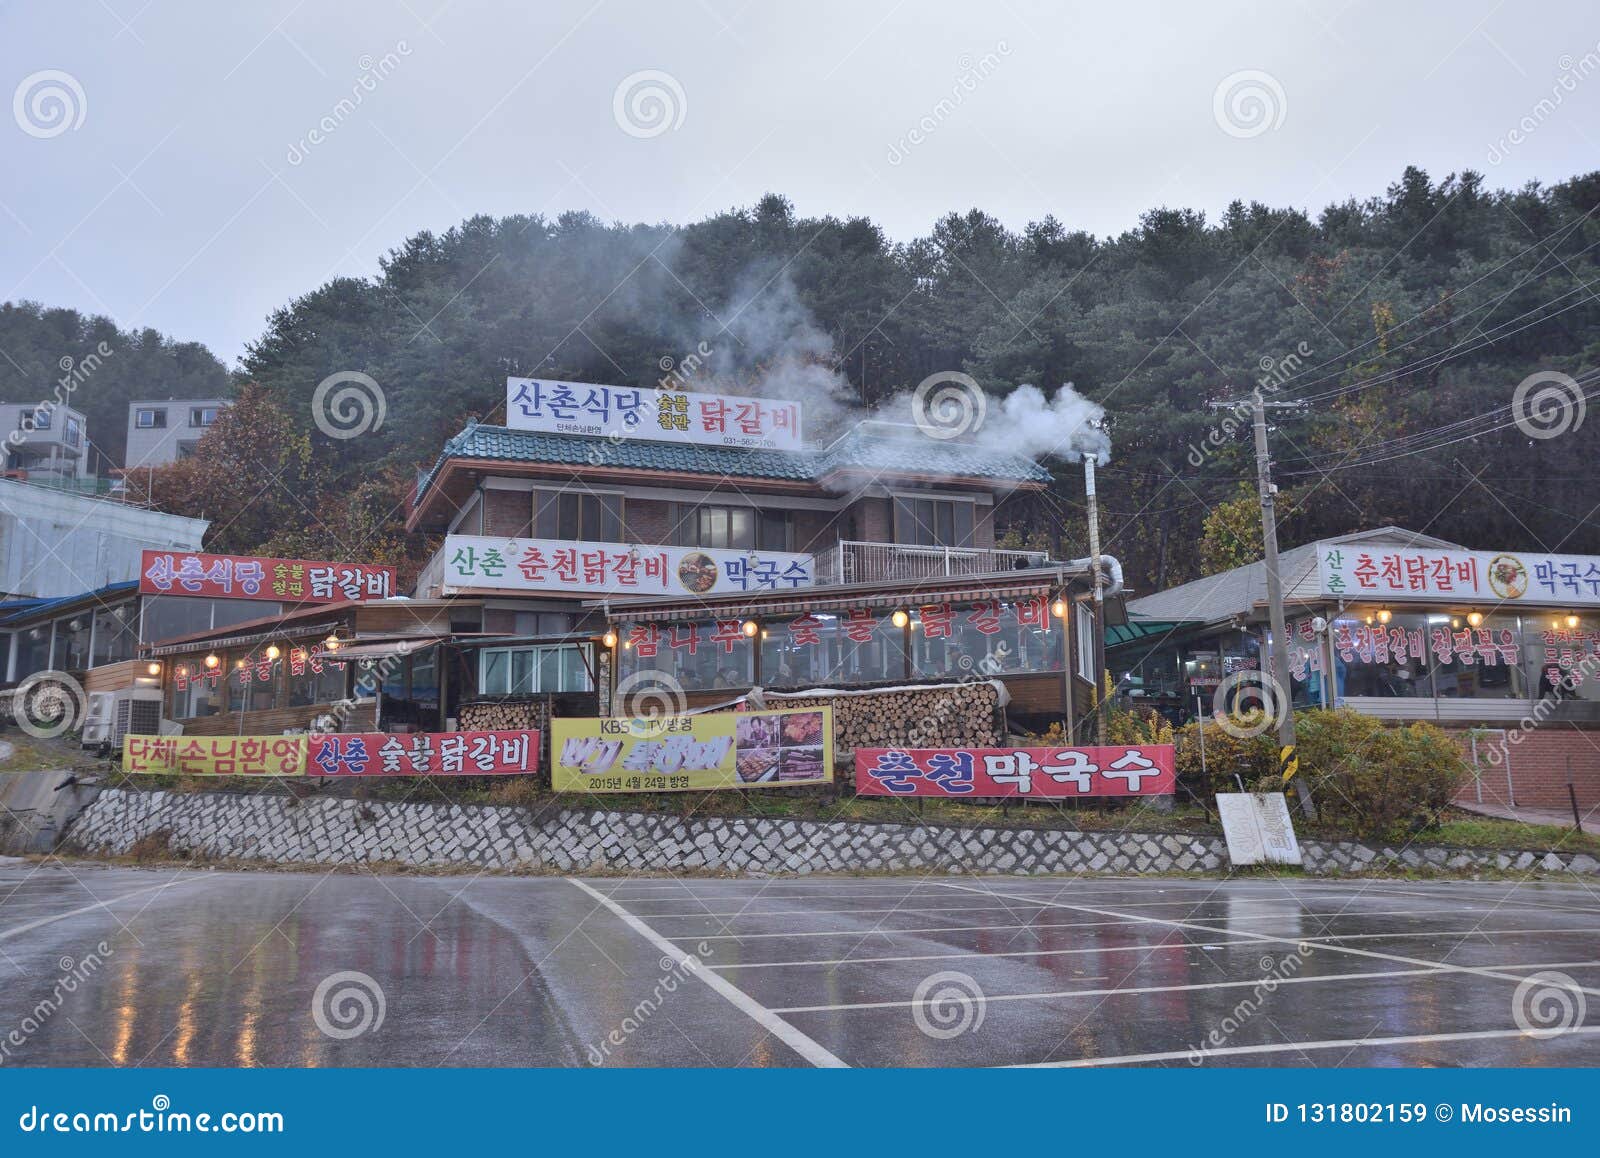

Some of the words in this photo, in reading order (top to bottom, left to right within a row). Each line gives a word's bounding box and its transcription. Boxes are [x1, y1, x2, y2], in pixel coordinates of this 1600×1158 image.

[511, 381, 642, 426] 산촌식당
[657, 393, 690, 412] 숯불
[699, 397, 799, 440] 닭갈비
[657, 412, 691, 431] 철판
[145, 555, 265, 594] 산촌식당
[272, 563, 305, 580] 숯불
[309, 566, 390, 600] 닭갈비
[450, 546, 507, 578] 산촌
[517, 546, 669, 587] 춘천닭갈비
[725, 557, 810, 590] 막국수
[1353, 553, 1479, 593] 춘천닭갈비
[272, 581, 304, 597] 철판
[629, 618, 743, 658] 참나무
[788, 607, 876, 645] 숯불
[918, 595, 1051, 639] 닭갈비
[1335, 625, 1427, 666] 춘천닭갈비
[1432, 626, 1520, 666] 철판볶음
[290, 643, 346, 676] 닭갈
[600, 720, 630, 735] KBS
[128, 737, 301, 774] 단체손님환영
[315, 737, 370, 773] 산촌
[867, 751, 975, 793] 춘천
[982, 750, 1161, 794] 막국수
[589, 777, 621, 789] 2015년
[625, 776, 641, 789] 4월
[644, 776, 665, 788] 24일
[670, 775, 689, 788] 방영
